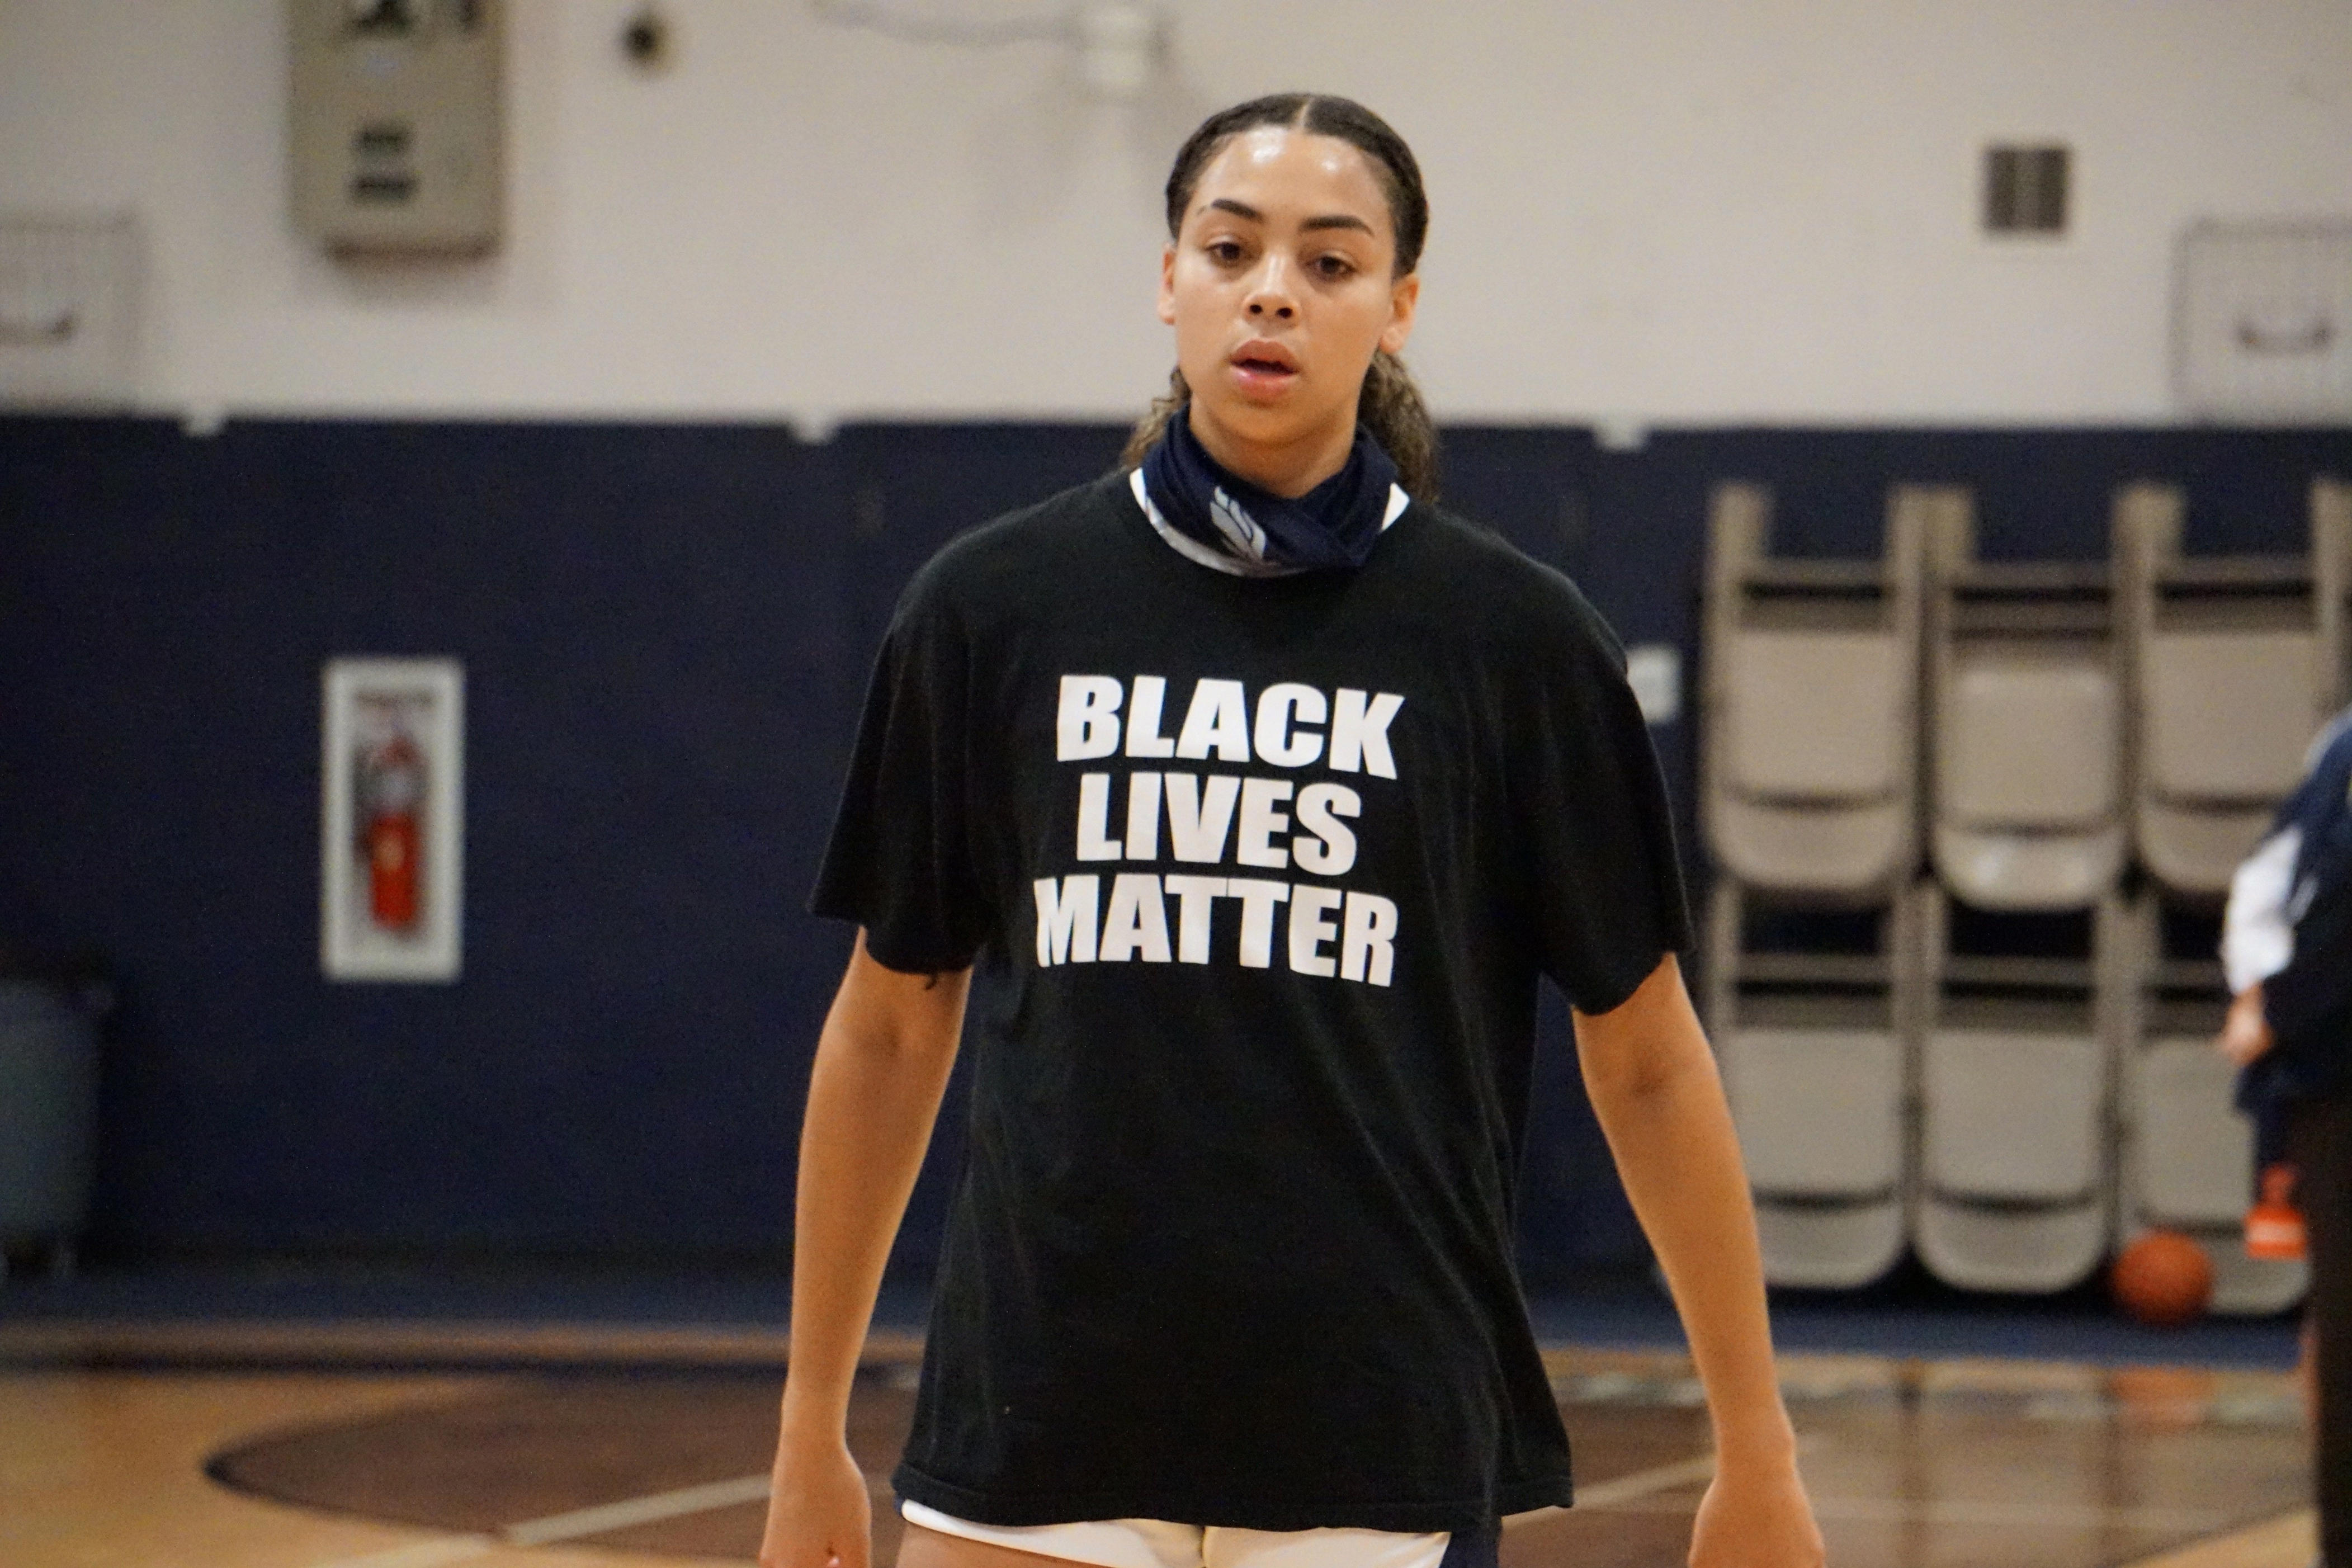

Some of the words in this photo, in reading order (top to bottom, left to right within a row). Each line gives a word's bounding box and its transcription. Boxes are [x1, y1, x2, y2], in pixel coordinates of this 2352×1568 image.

[1056, 674, 1405, 780] BLACK
[1076, 771, 1362, 876] LIVES
[1033, 873, 1399, 988] MATTER
